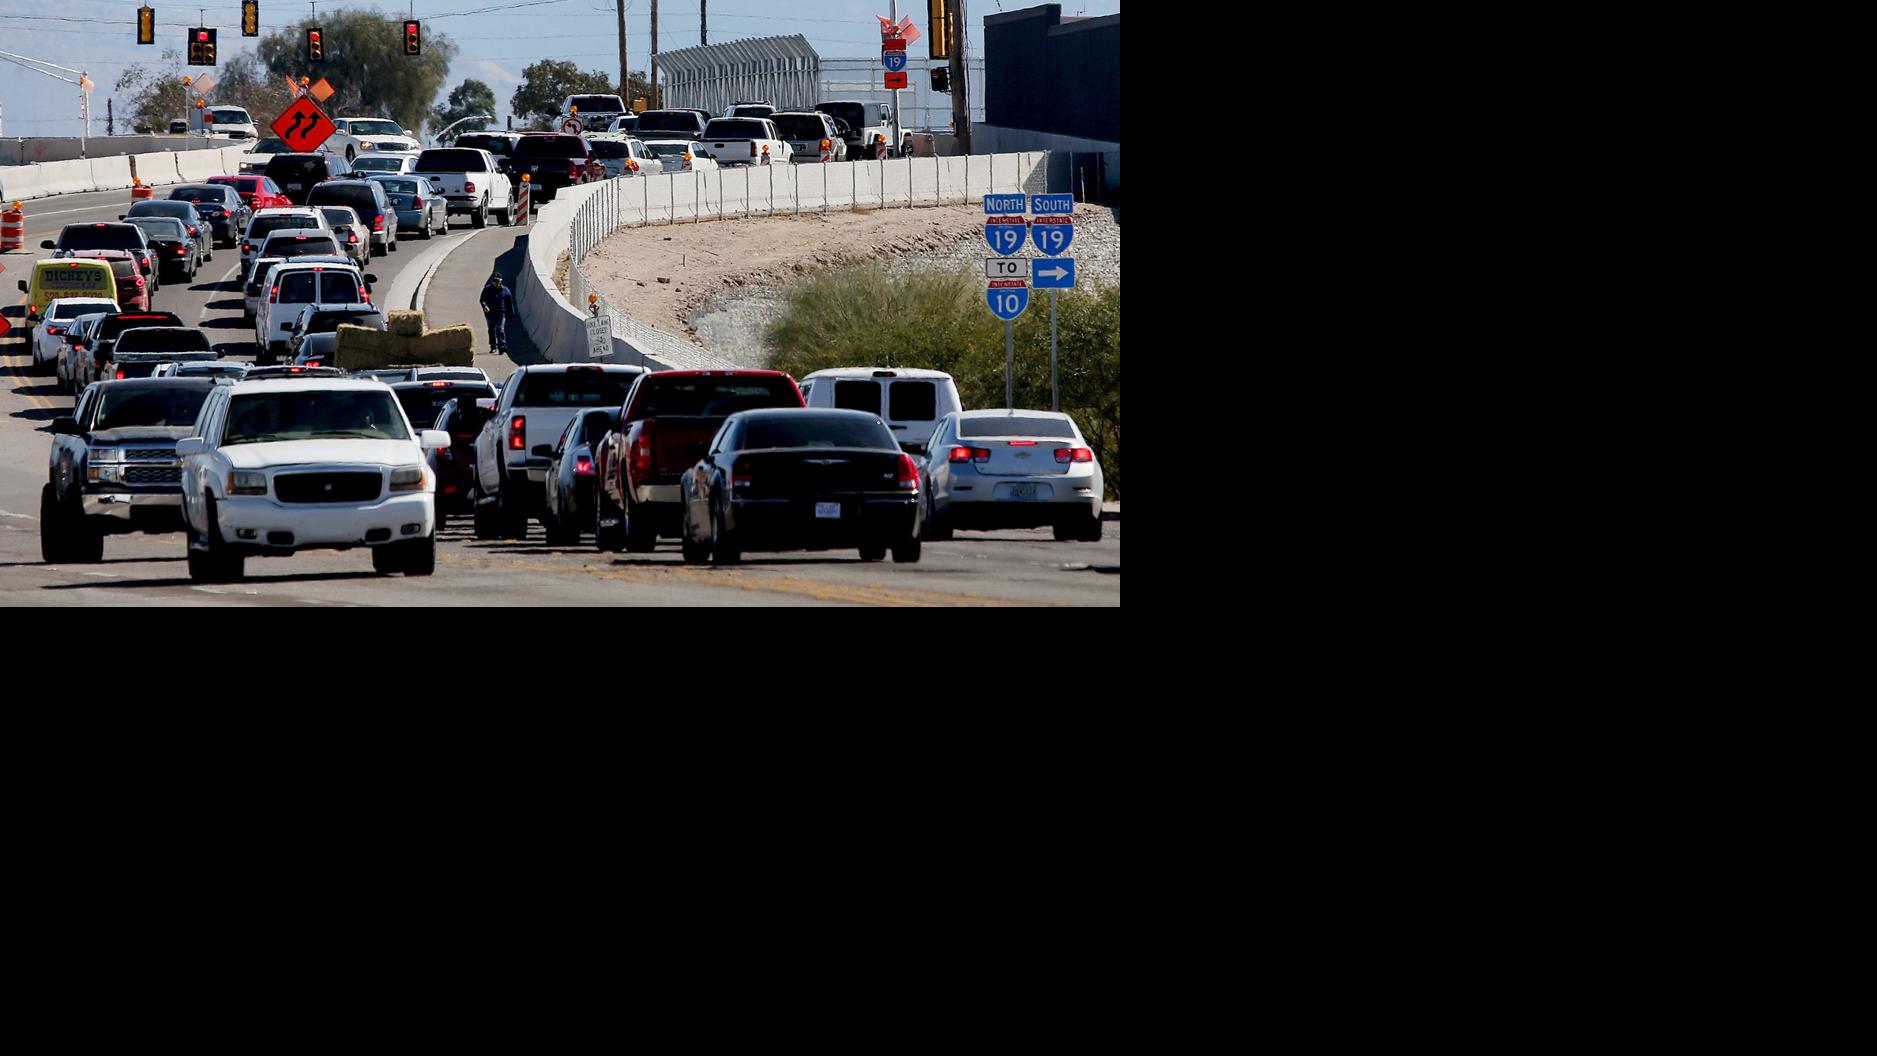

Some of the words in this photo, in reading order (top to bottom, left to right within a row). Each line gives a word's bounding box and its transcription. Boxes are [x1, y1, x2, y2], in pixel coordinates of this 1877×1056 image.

[889, 57, 901, 67] 19
[987, 198, 1023, 211] NORTH
[1034, 198, 1070, 211] SOUTH
[994, 230, 1018, 249] 19
[1041, 230, 1064, 249] 19
[997, 262, 1017, 273] TO
[996, 294, 1019, 313] 10
